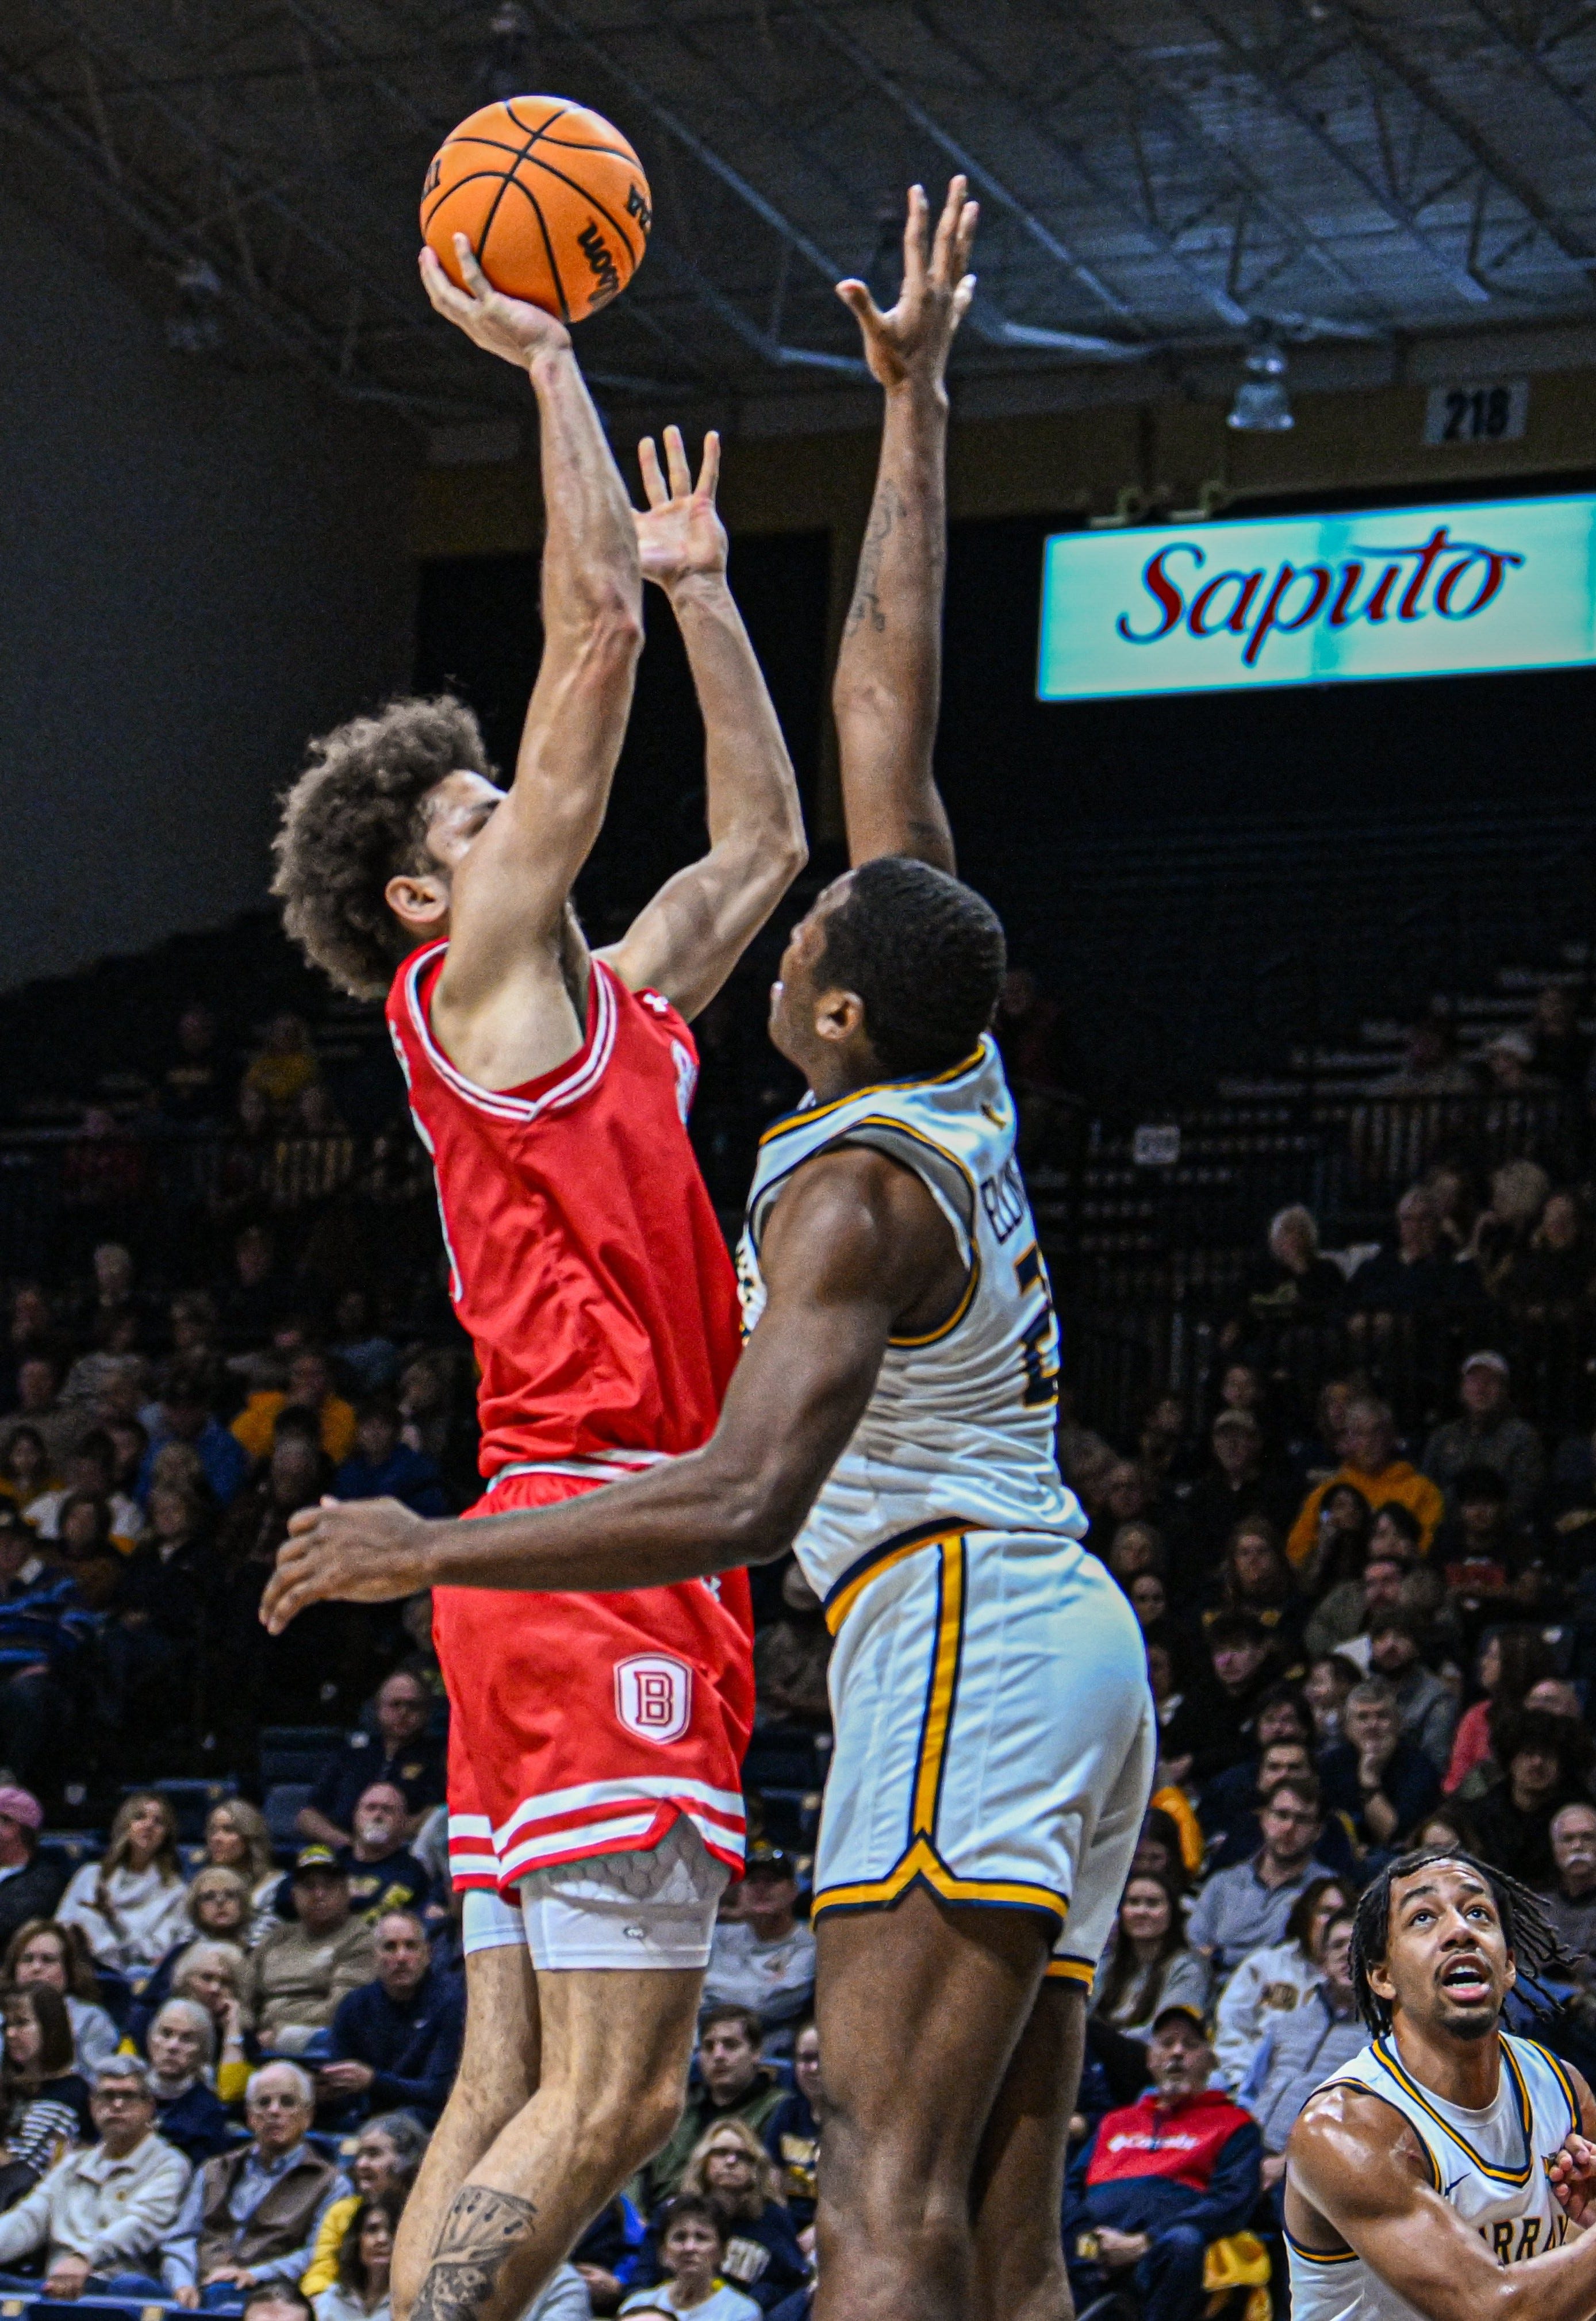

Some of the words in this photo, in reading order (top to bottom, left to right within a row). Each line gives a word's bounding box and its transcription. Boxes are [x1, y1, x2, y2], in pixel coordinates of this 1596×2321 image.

[1442, 386, 1511, 440] 218
[1116, 525, 1525, 667] Saputo
[634, 1671, 673, 1727] B
